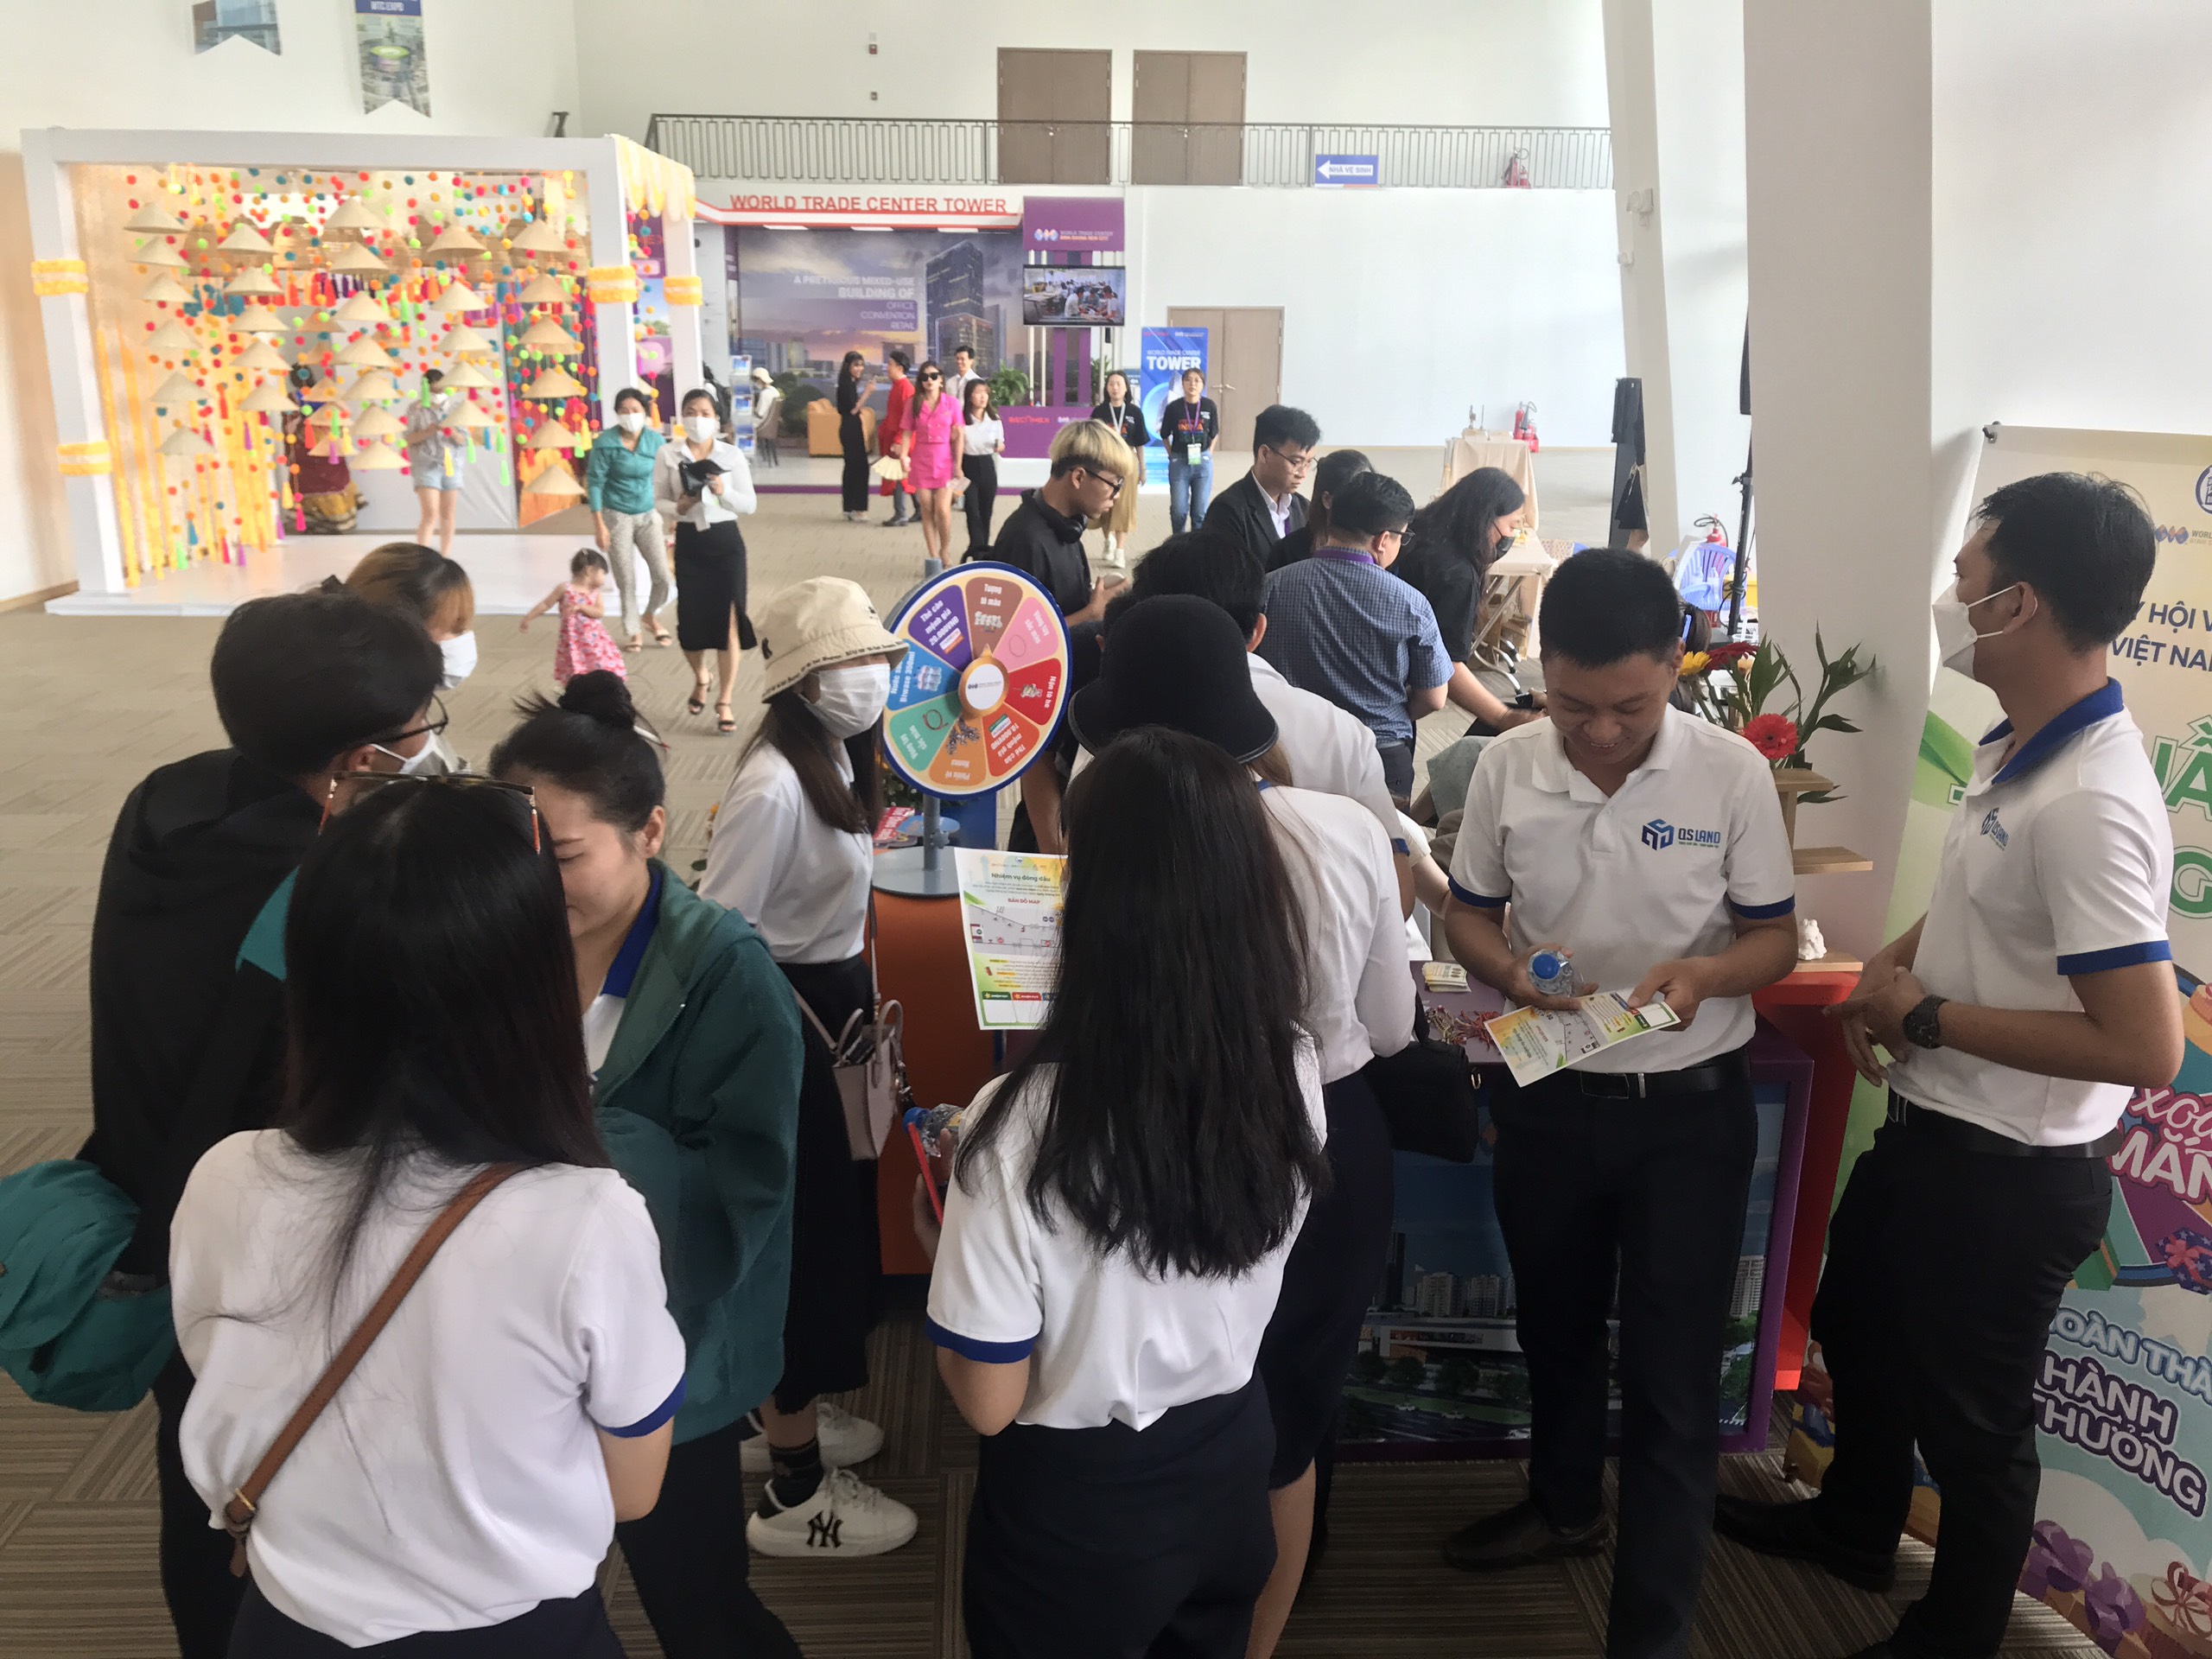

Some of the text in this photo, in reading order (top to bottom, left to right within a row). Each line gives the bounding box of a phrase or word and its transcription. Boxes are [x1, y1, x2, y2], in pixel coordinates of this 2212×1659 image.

[730, 195, 1007, 213] WORLD TRADE CENTER TOWER
[838, 287, 915, 298] BUILDING OF
[1146, 356, 1202, 371] TOWER
[2149, 601, 2196, 633] HỘI
[2112, 634, 2212, 671] VIỆT NA
[1695, 830, 1721, 844] LAND
[2050, 1307, 2140, 1364] OÀN
